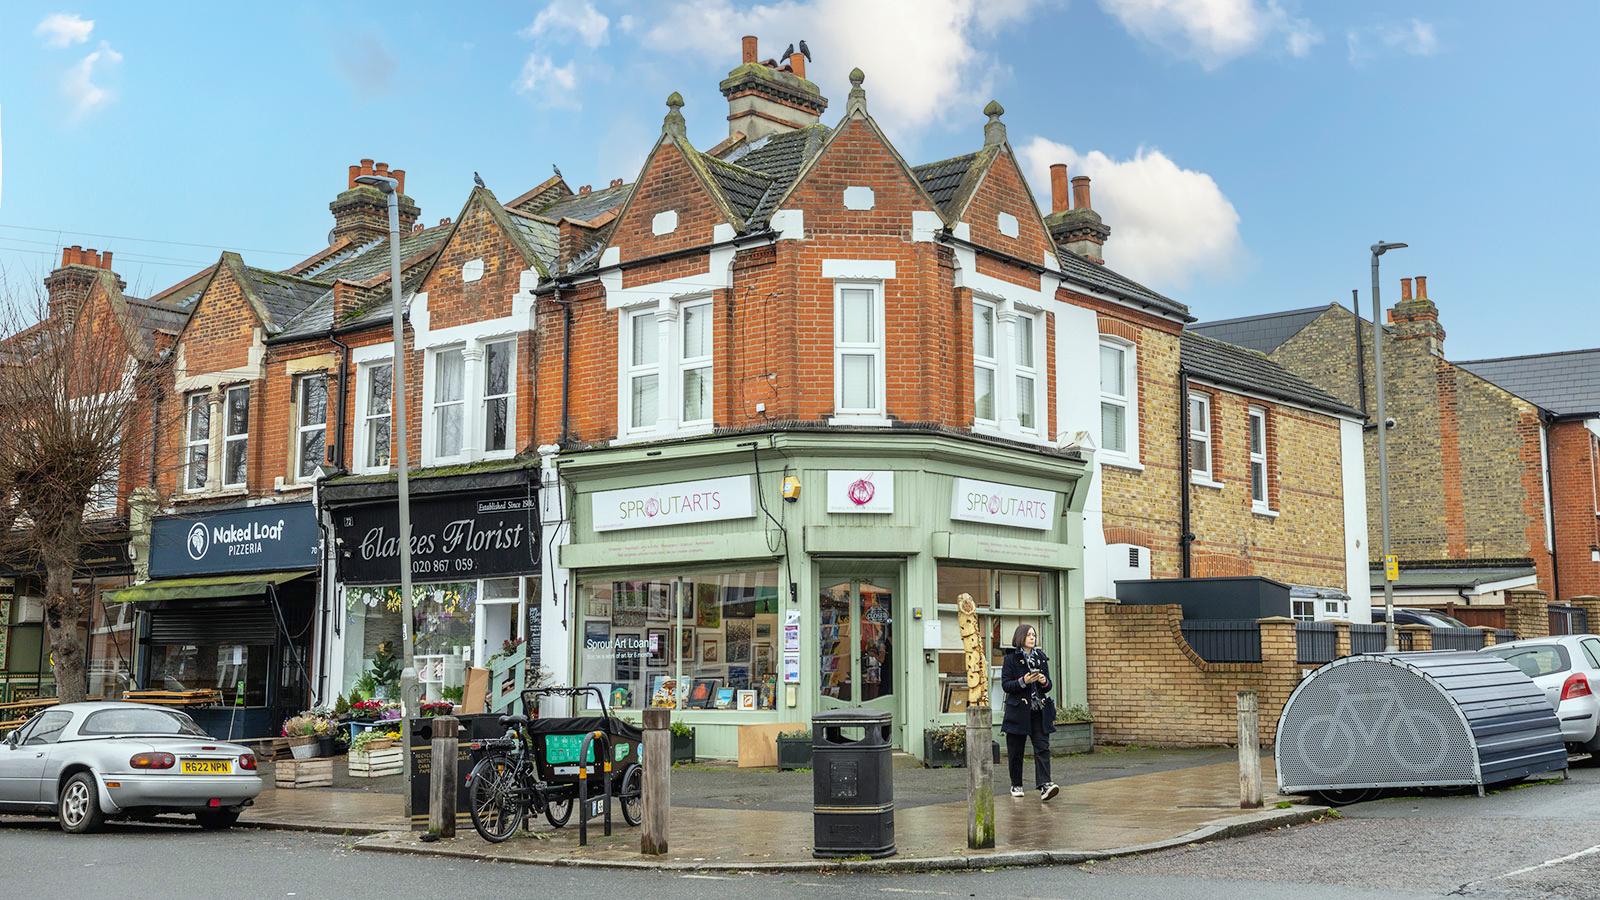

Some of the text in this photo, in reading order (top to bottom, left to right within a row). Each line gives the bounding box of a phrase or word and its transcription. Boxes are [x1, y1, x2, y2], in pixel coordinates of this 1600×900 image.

[507, 500, 521, 509] Since
[619, 491, 721, 520] SPROUTARTS
[967, 492, 1047, 520] SPROUTARTS
[213, 519, 285, 544] Naked Loaf
[442, 518, 524, 554] Florist
[228, 542, 262, 556] PIZZERIA
[412, 560, 431, 573] 020
[586, 638, 613, 650] Sprout
[614, 637, 627, 649] Art
[185, 762, 228, 772] R622 NPN
